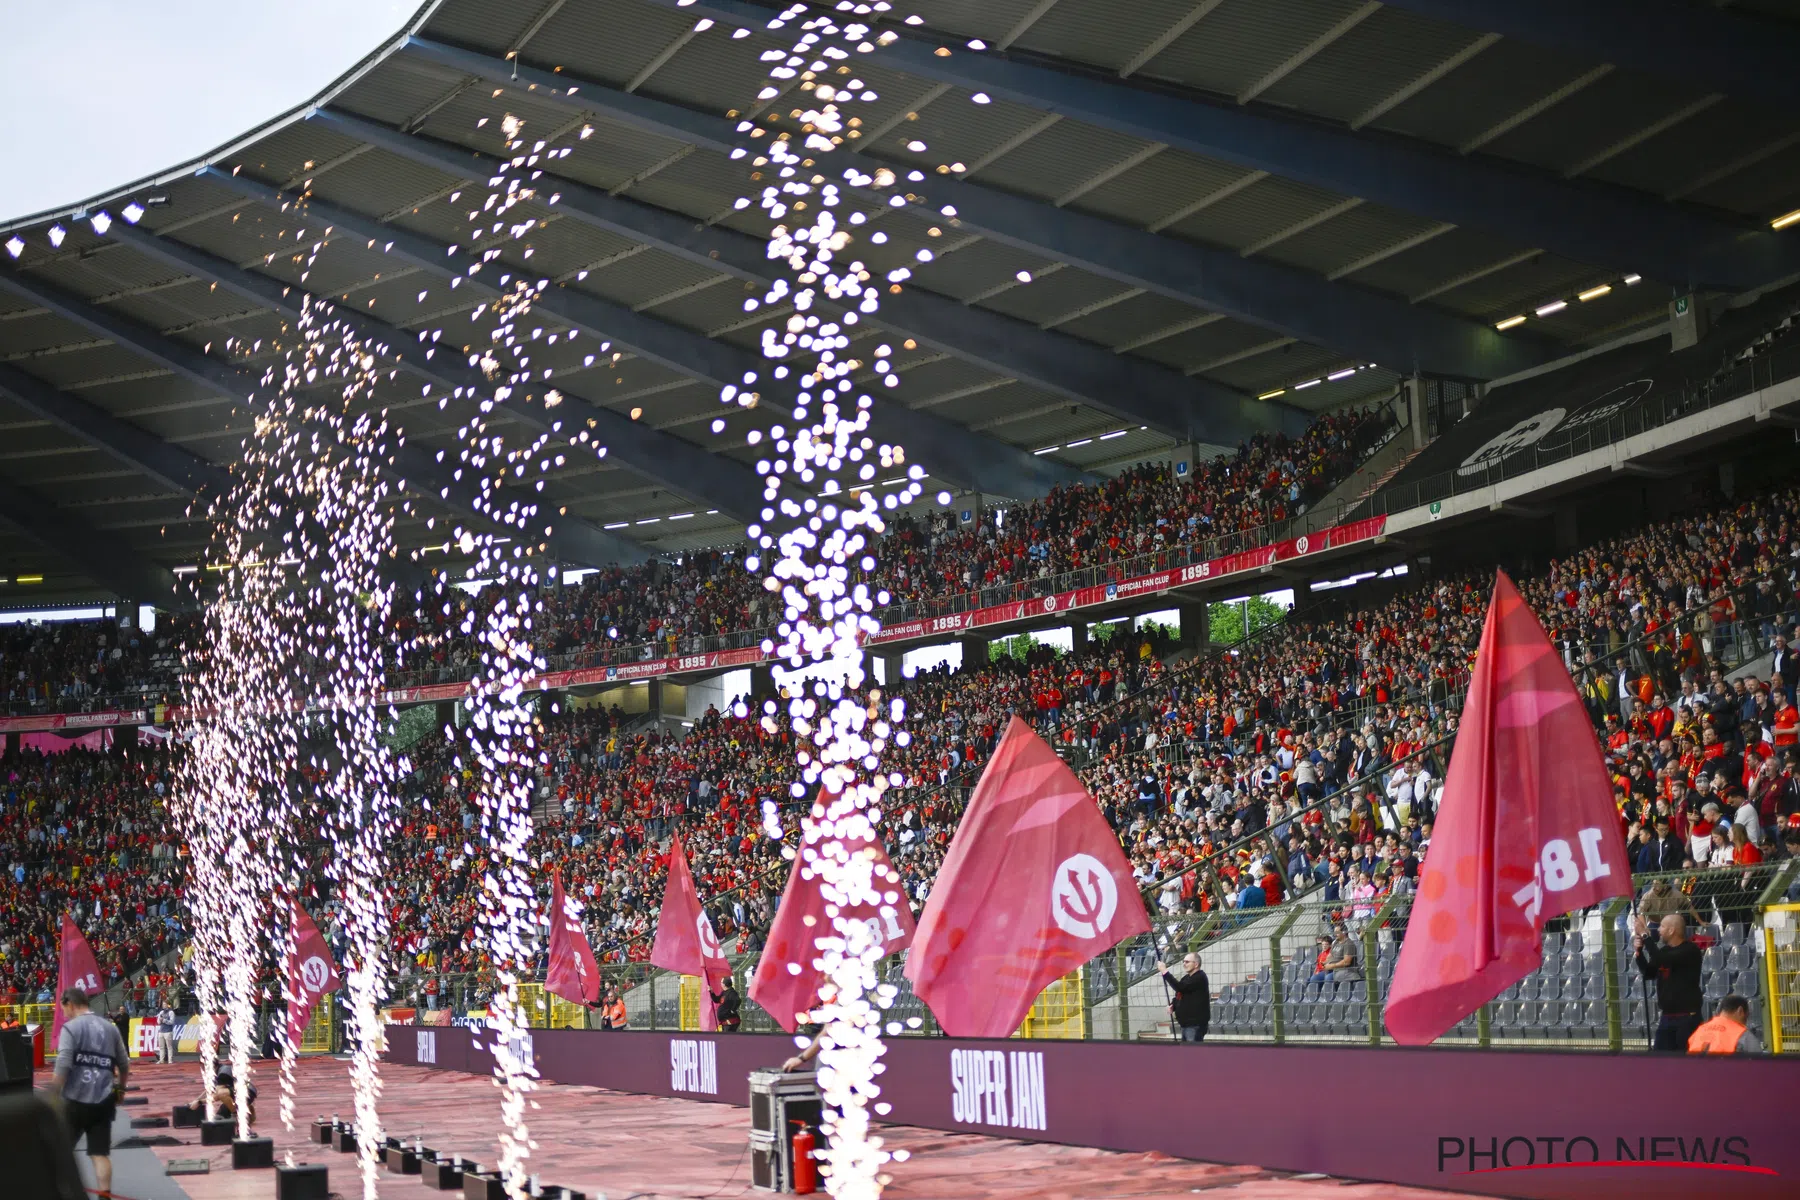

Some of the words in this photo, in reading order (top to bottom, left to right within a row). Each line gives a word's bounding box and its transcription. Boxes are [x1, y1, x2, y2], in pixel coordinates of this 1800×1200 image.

[1117, 582, 1142, 593] OFFICIAL
[1142, 577, 1154, 587] FAN
[1154, 575, 1170, 585] CLUB
[1181, 562, 1210, 581] 1895
[870, 629, 894, 639] OFFICIAL
[894, 627, 906, 635] FAN
[906, 623, 921, 633] CLUB
[932, 615, 961, 631] 1895
[617, 665, 641, 675] OFFICIAL
[641, 664, 652, 672] FAN
[678, 655, 706, 669] 1895
[65, 714, 90, 723] OFFICIAL
[91, 714, 101, 722] FAN
[101, 713, 119, 721] CLUB
[671, 1039, 699, 1092] SUPER
[699, 1041, 717, 1095] JAN
[951, 1048, 1008, 1126] SUPER
[1009, 1051, 1047, 1131] JAN
